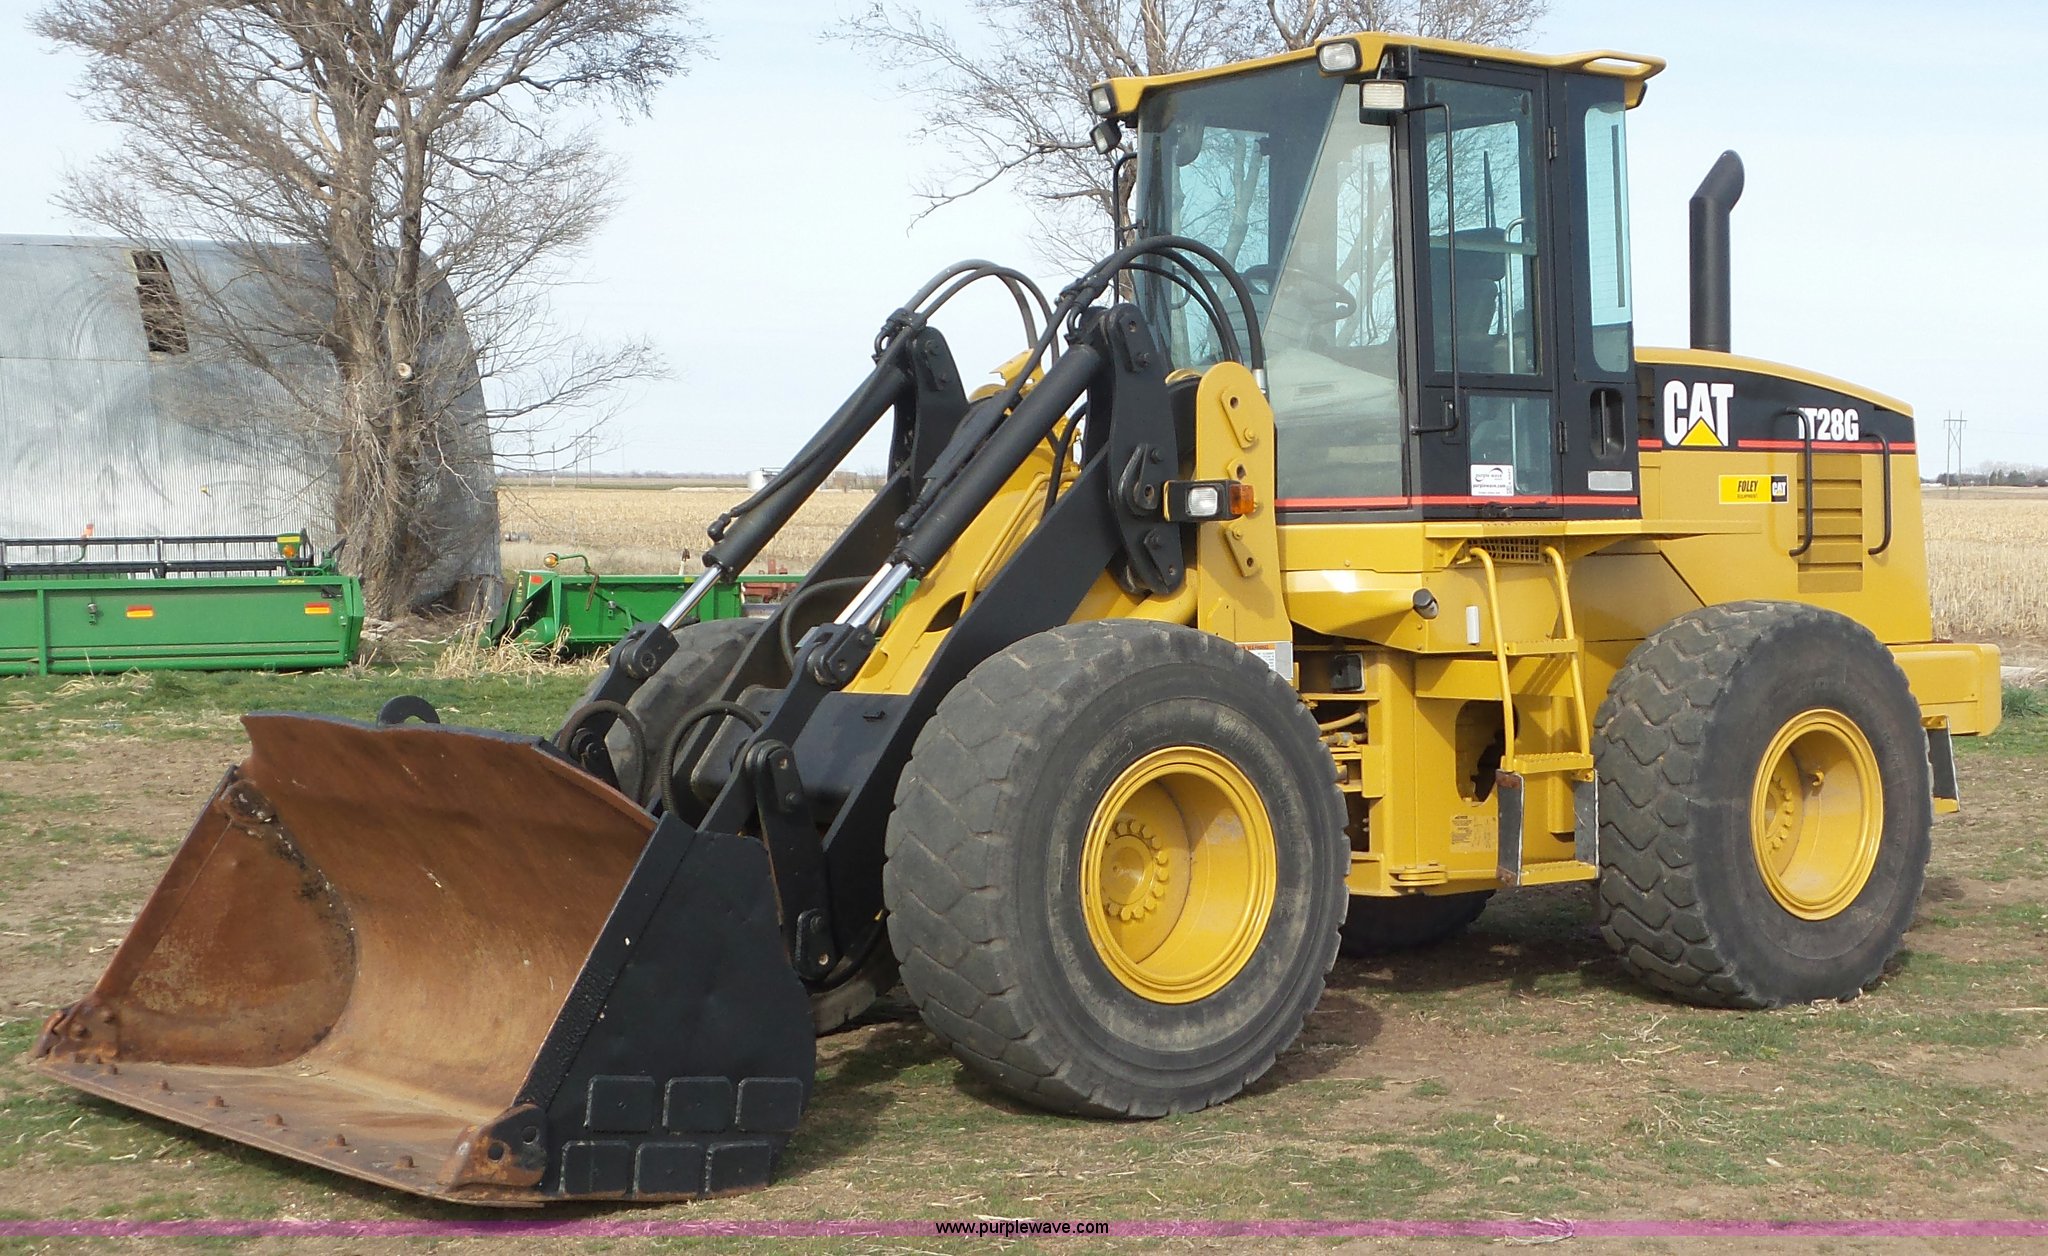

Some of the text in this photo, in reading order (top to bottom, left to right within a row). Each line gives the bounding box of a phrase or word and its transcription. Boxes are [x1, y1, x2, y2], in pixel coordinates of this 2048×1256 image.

[1664, 380, 1734, 447] CAT
[1737, 480, 1758, 492] FOLEY
[1772, 481, 1787, 497] CAT
